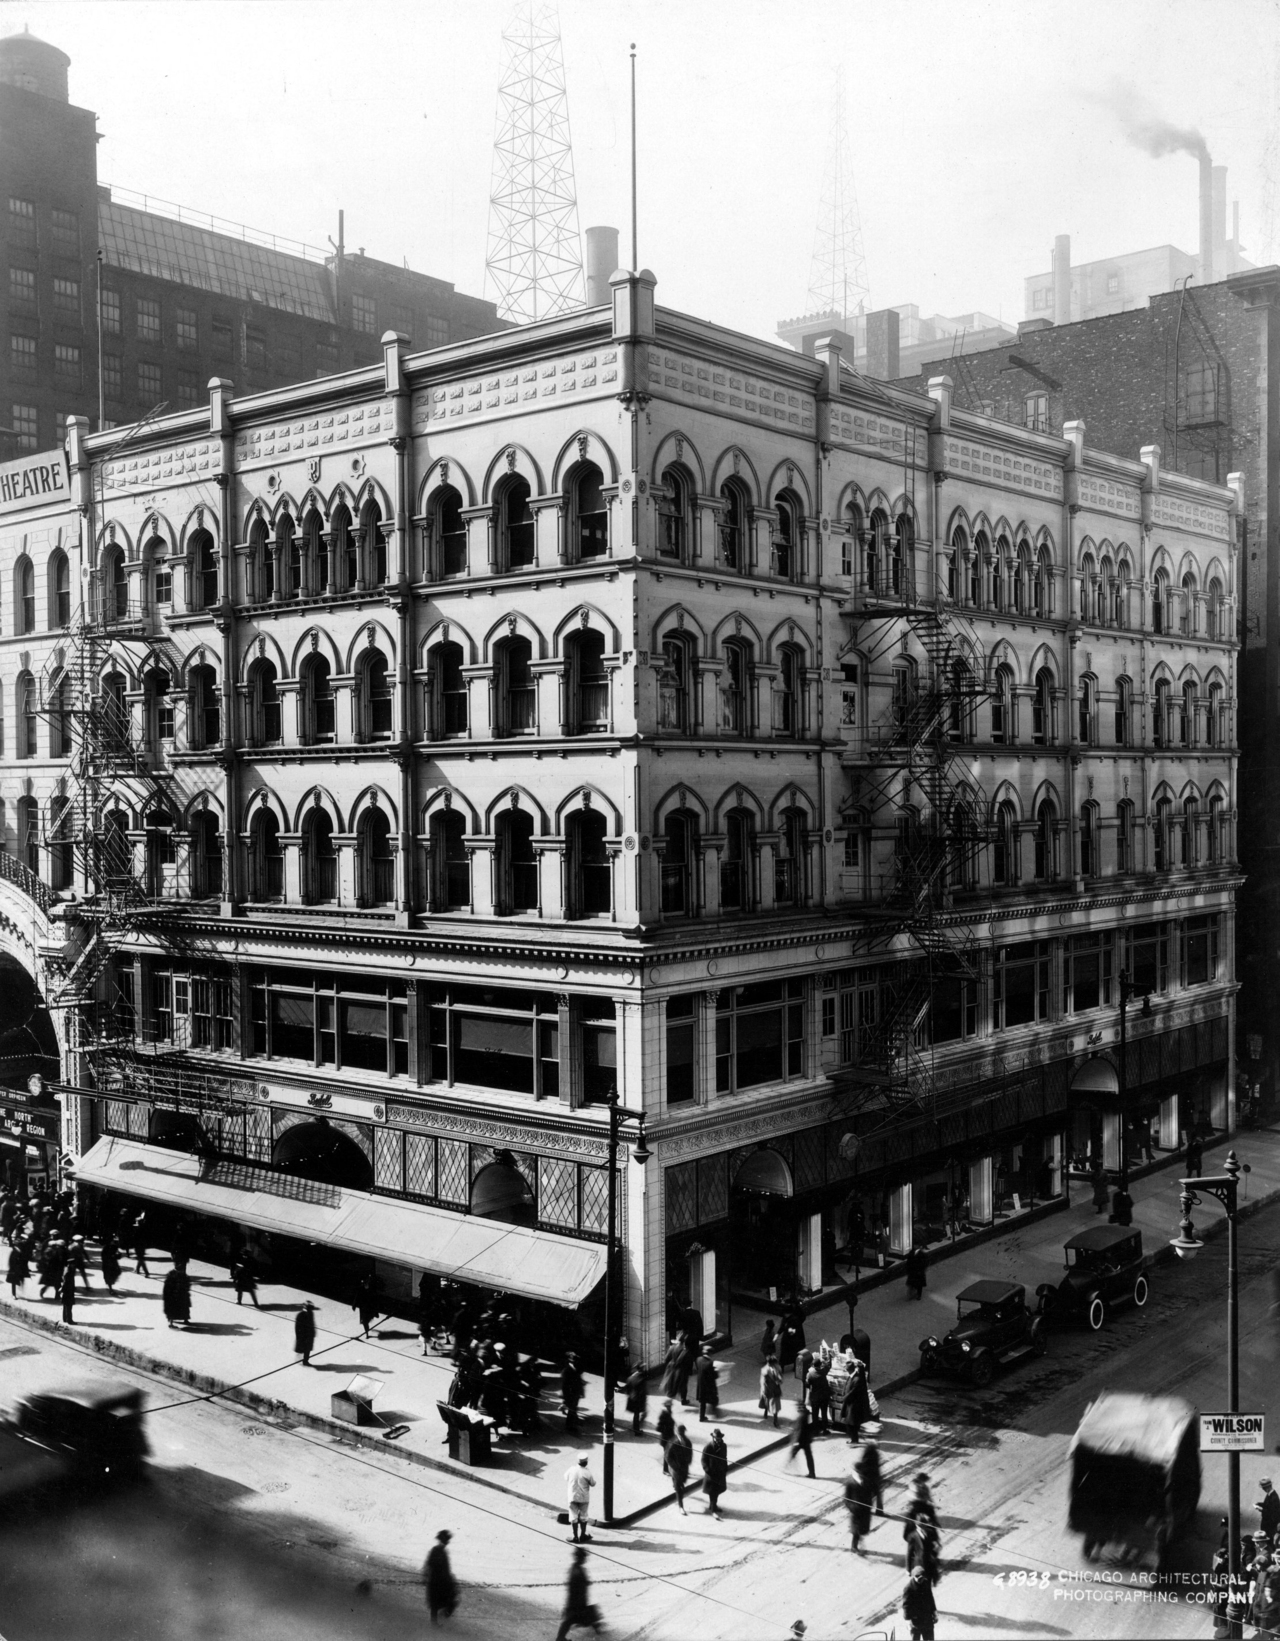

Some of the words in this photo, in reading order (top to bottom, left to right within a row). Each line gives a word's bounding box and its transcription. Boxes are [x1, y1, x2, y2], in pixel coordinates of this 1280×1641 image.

[0, 462, 64, 502] HEATRE
[15, 1111, 32, 1122] NORTH
[27, 1124, 45, 1136] REGION
[1212, 1418, 1262, 1432] WILSON
